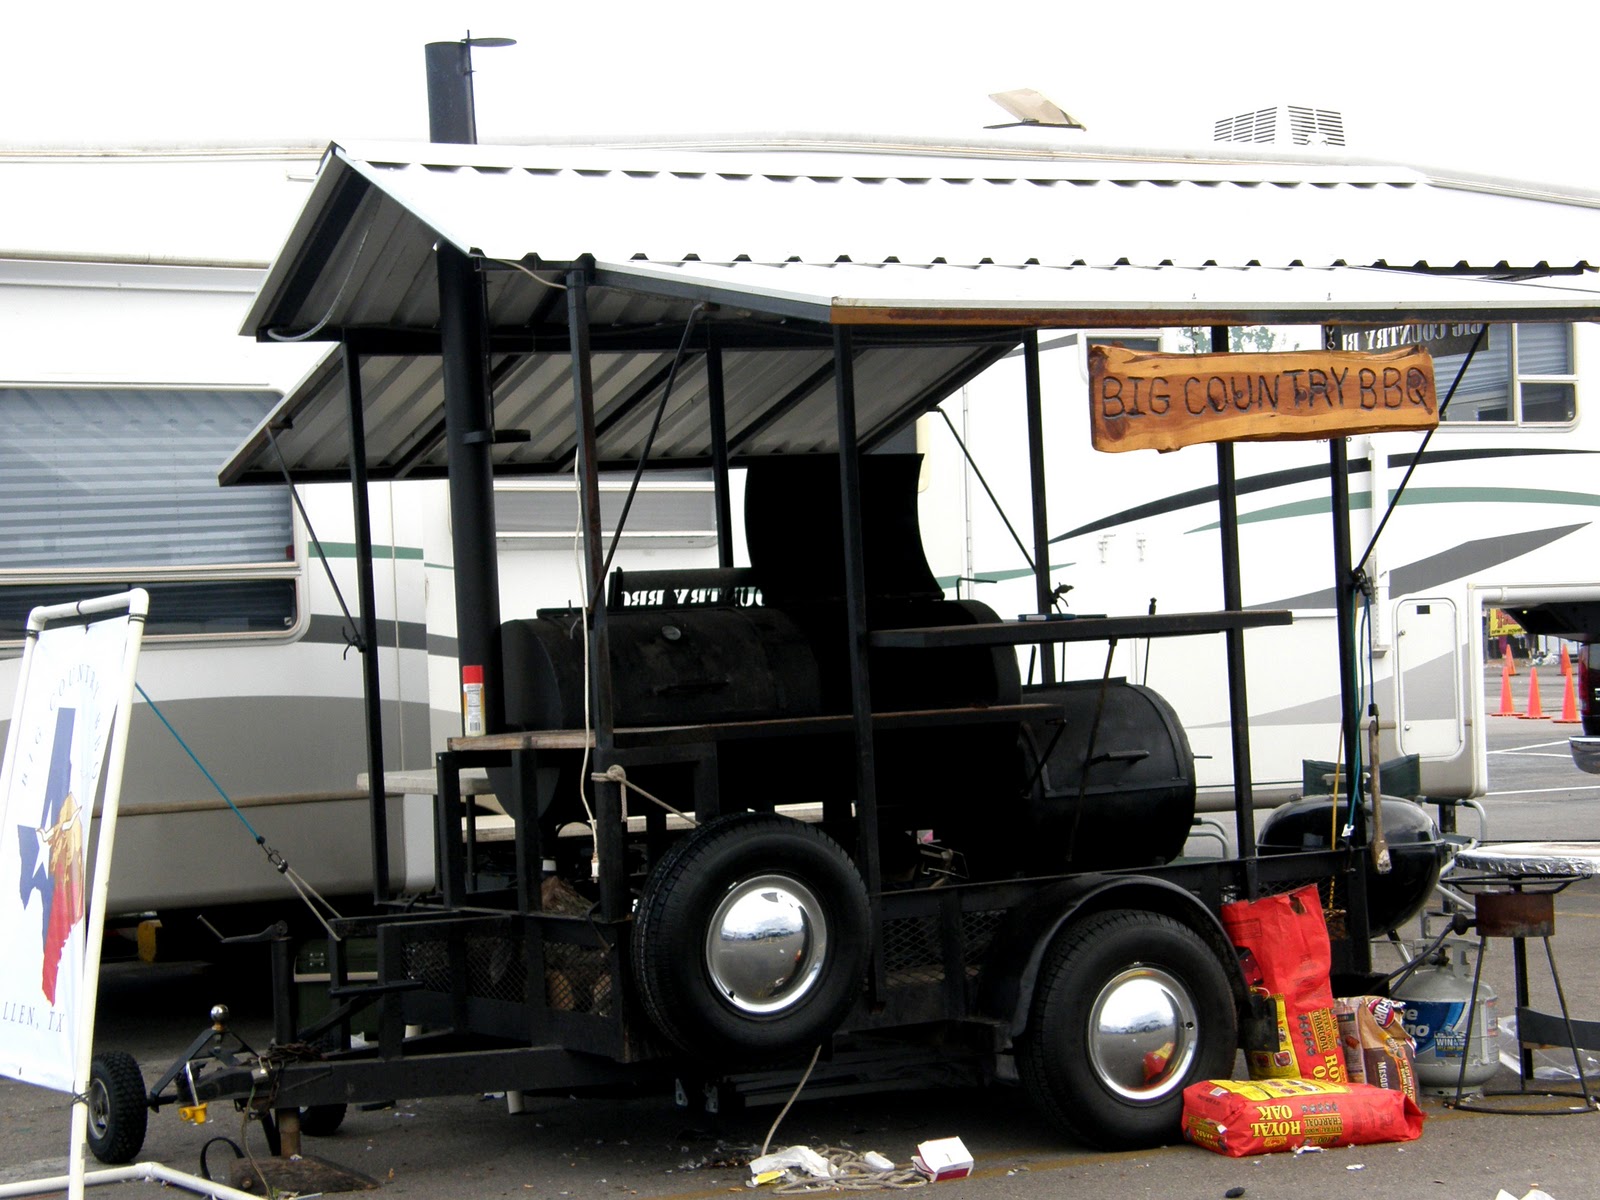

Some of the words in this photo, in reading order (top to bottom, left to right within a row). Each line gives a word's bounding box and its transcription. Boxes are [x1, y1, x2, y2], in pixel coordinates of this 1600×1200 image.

[1101, 376, 1171, 420] BIG
[1184, 366, 1350, 417] COUNTRY
[1359, 366, 1435, 416] BBQ
[48, 1011, 65, 1033] TX
[1312, 1011, 1328, 1052] CHARCOAL
[1256, 1103, 1293, 1120] OAK
[1304, 1116, 1343, 1127] CHARCOAL
[1250, 1120, 1302, 1138] ROYAL
